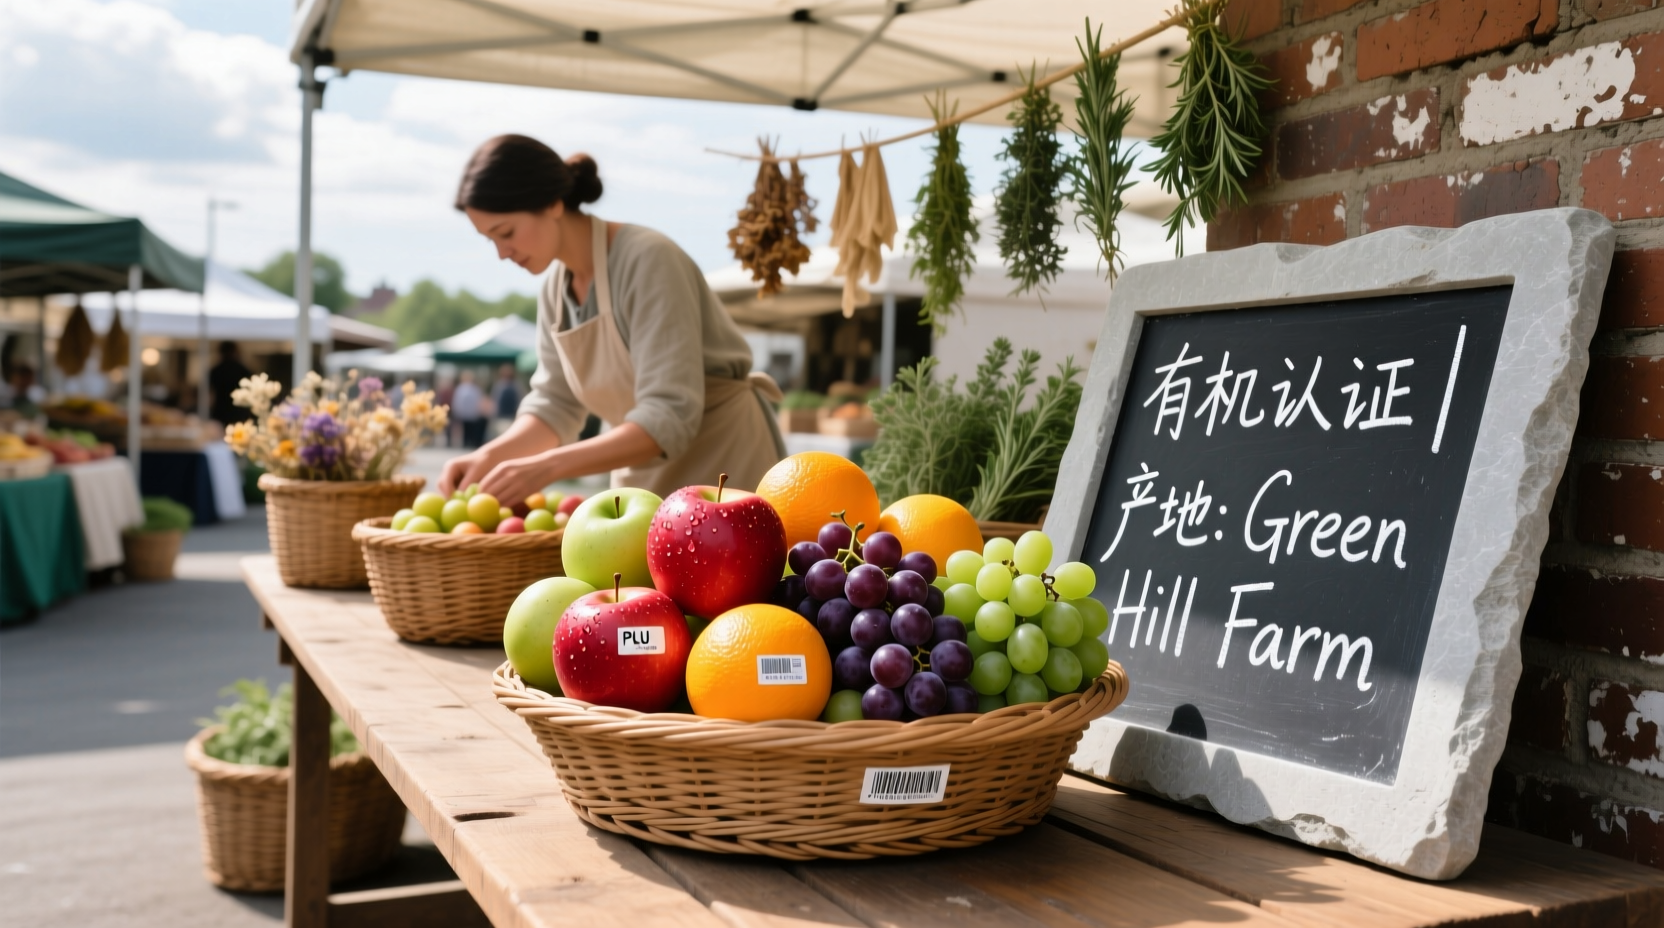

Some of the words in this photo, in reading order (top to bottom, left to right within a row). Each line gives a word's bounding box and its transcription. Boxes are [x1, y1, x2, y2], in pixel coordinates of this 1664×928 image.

[1143, 342, 1415, 440] 有机认证
[1100, 462, 1228, 562] 产地:
[1244, 469, 1407, 569] Green
[622, 630, 650, 646] PLU
[1107, 569, 1198, 657] Hill
[1216, 582, 1375, 692] Farm
